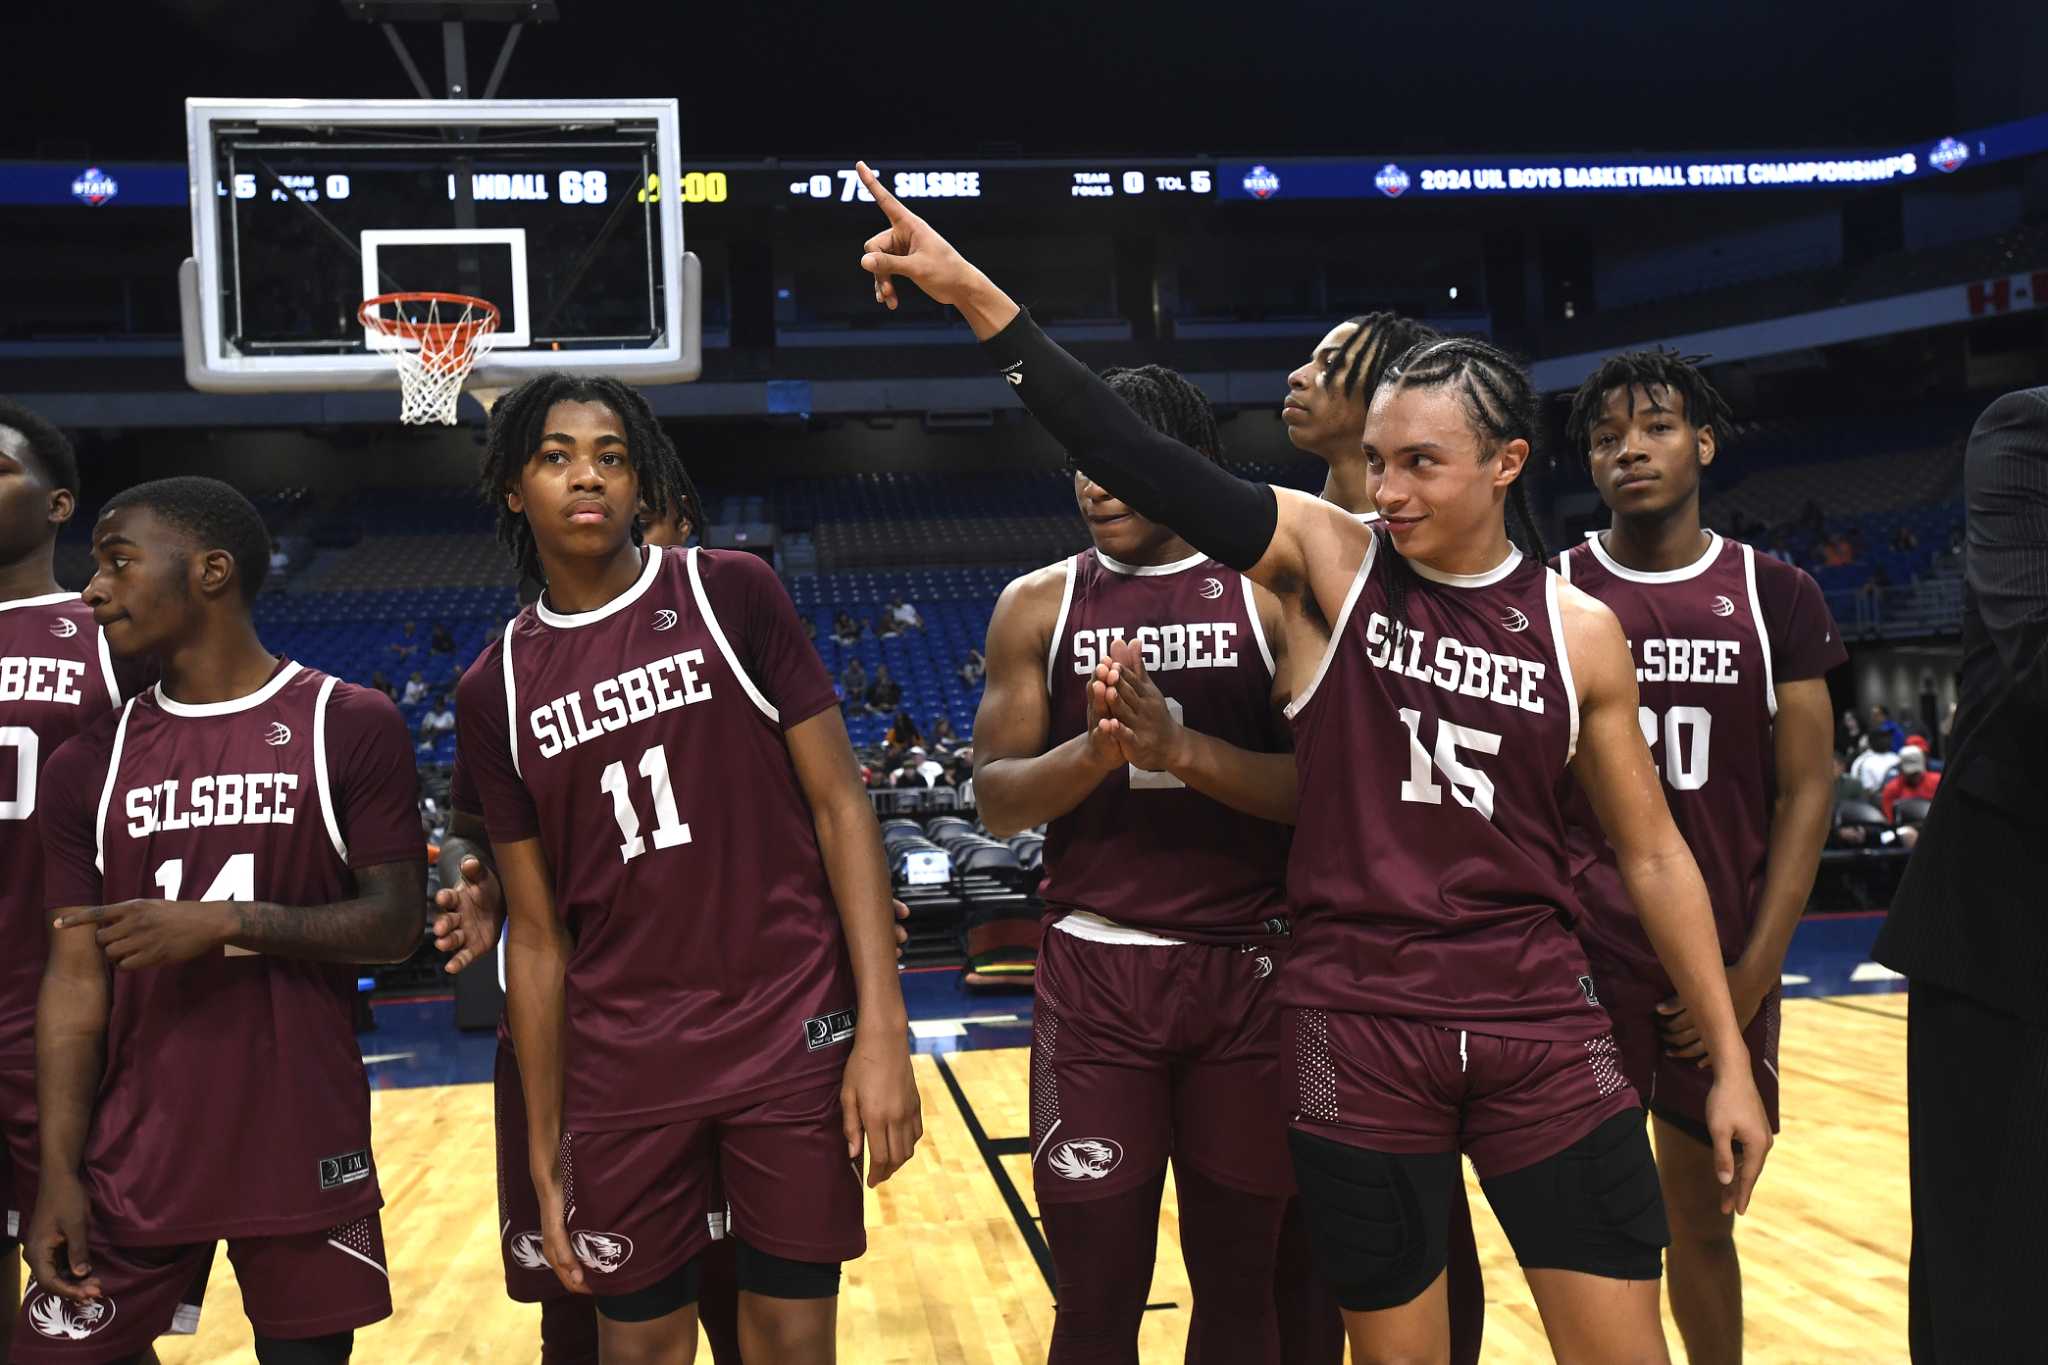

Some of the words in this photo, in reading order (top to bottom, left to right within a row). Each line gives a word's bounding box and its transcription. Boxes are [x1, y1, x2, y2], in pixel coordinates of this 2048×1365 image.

[234, 174, 256, 199] 5
[326, 174, 350, 199] 0
[809, 175, 832, 198] 0
[894, 171, 980, 198] SILSBEE
[1073, 172, 1110, 184] TEAM
[1122, 170, 1144, 194] 0
[1155, 175, 1186, 191] TOL
[1190, 170, 1211, 194] 5
[1420, 169, 1471, 190] 2024
[1473, 168, 1506, 189] UIL
[1508, 167, 1562, 189] BOYS
[1564, 165, 1685, 188] BASKETBALL
[1688, 164, 1745, 185] STATE
[1748, 153, 1917, 185] CHAMPIONSHIPS
[558, 170, 608, 204] 68
[1071, 185, 1114, 197] FOULS
[1366, 612, 1545, 714] SILSBEE
[1627, 638, 1741, 685] SBEE
[530, 648, 713, 759] SILSBEE
[1398, 707, 1502, 822] 15
[126, 772, 298, 838] SILSBEE
[600, 744, 693, 865] 11
